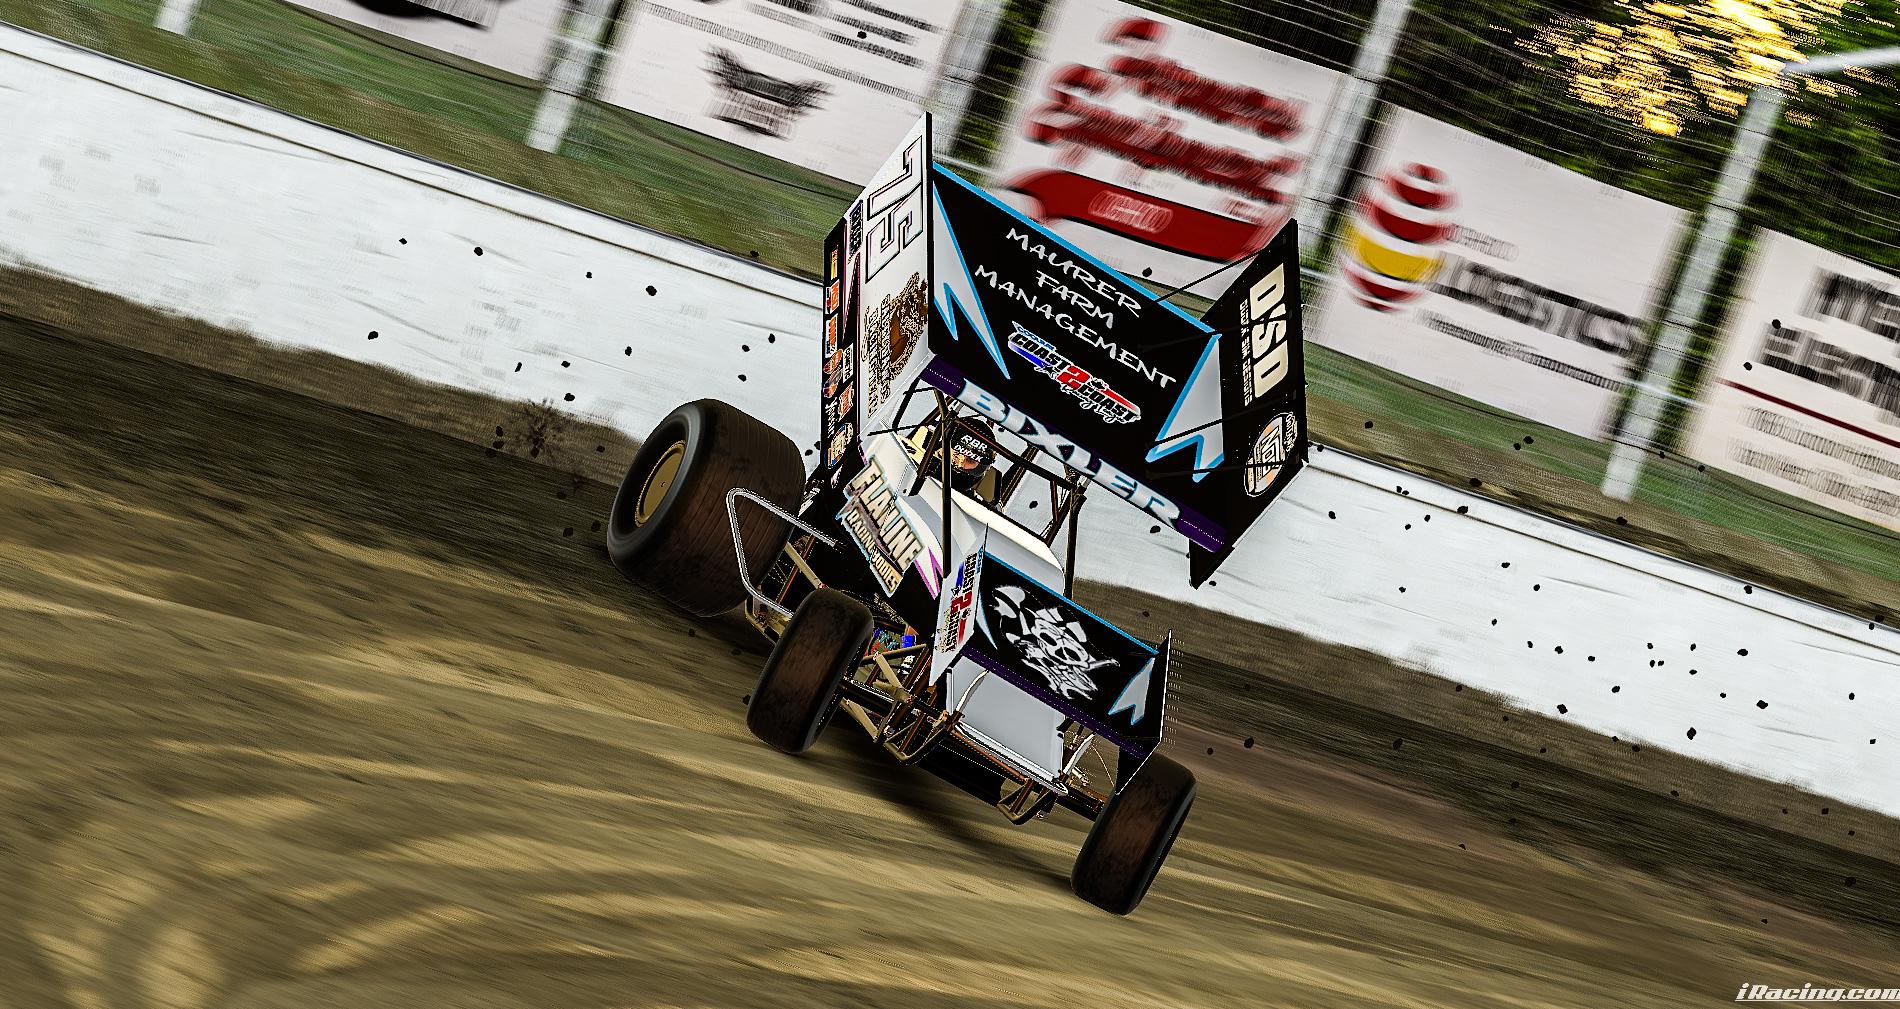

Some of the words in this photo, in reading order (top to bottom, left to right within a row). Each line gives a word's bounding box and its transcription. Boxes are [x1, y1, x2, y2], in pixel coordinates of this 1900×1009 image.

[865, 135, 923, 284] 75
[1006, 228, 1142, 318] MAURER
[1036, 270, 1115, 329] FARM
[974, 265, 1177, 389] MANAGEMENT
[1010, 333, 1071, 373] COAST
[1056, 365, 1092, 391] 2
[1080, 384, 1138, 421] COAST
[1250, 262, 1289, 398] DSD
[957, 378, 1182, 530] BIXLER
[960, 434, 988, 453] RBR
